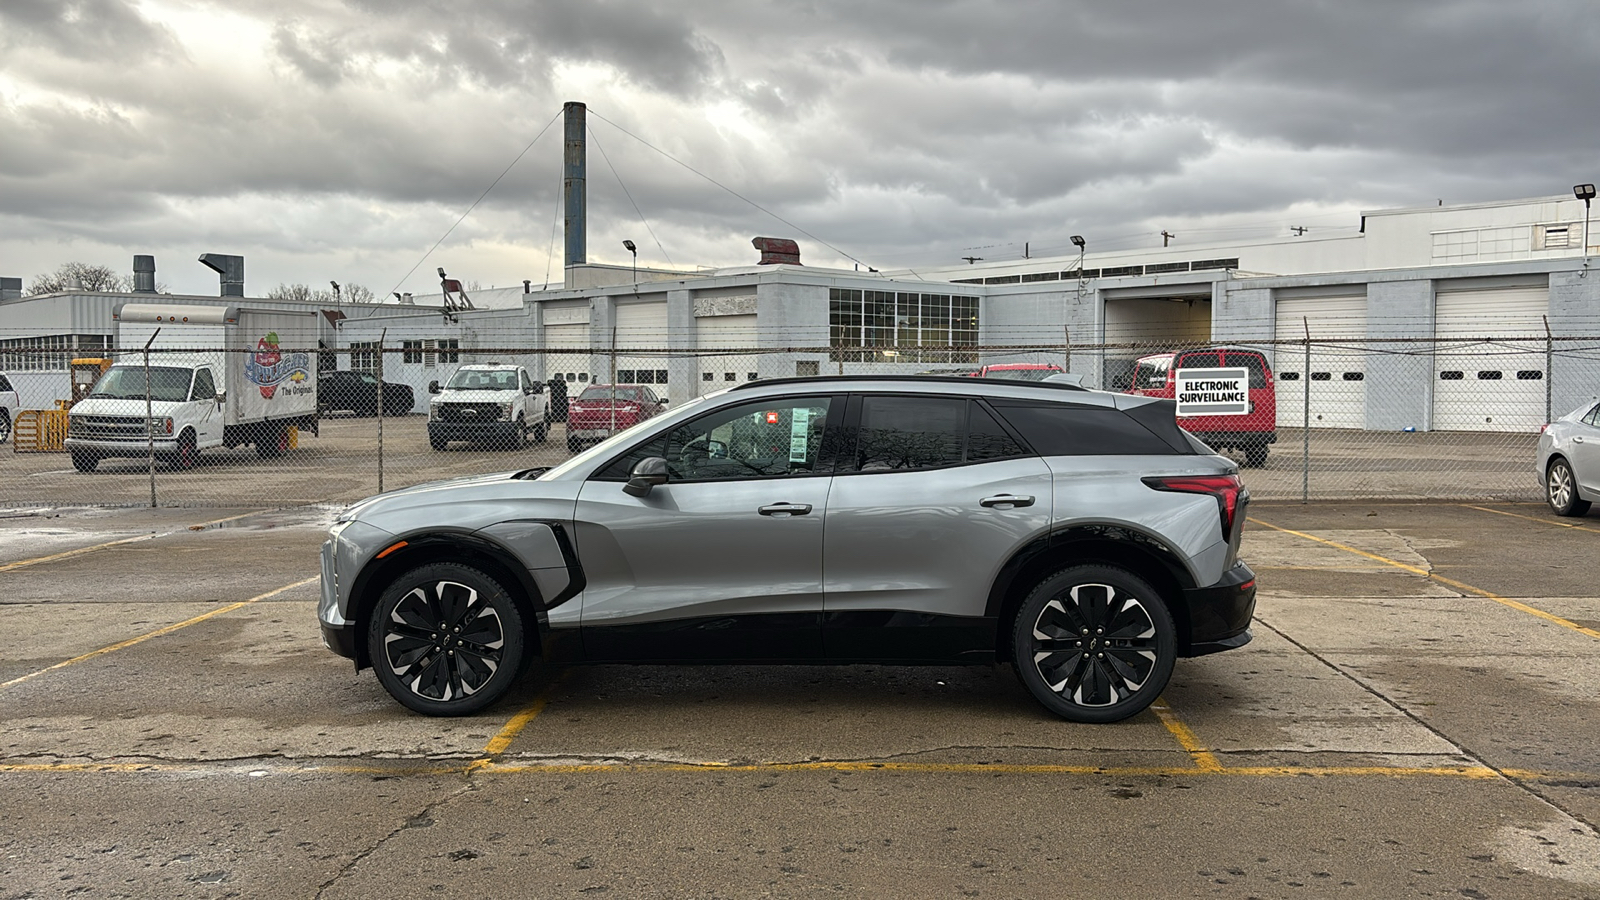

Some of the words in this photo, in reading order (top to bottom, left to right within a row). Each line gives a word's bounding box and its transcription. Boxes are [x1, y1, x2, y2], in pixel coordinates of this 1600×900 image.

[1185, 381, 1238, 391] ELECTRONIC
[282, 387, 291, 396] The
[1179, 392, 1244, 403] SURVEILLANCE
